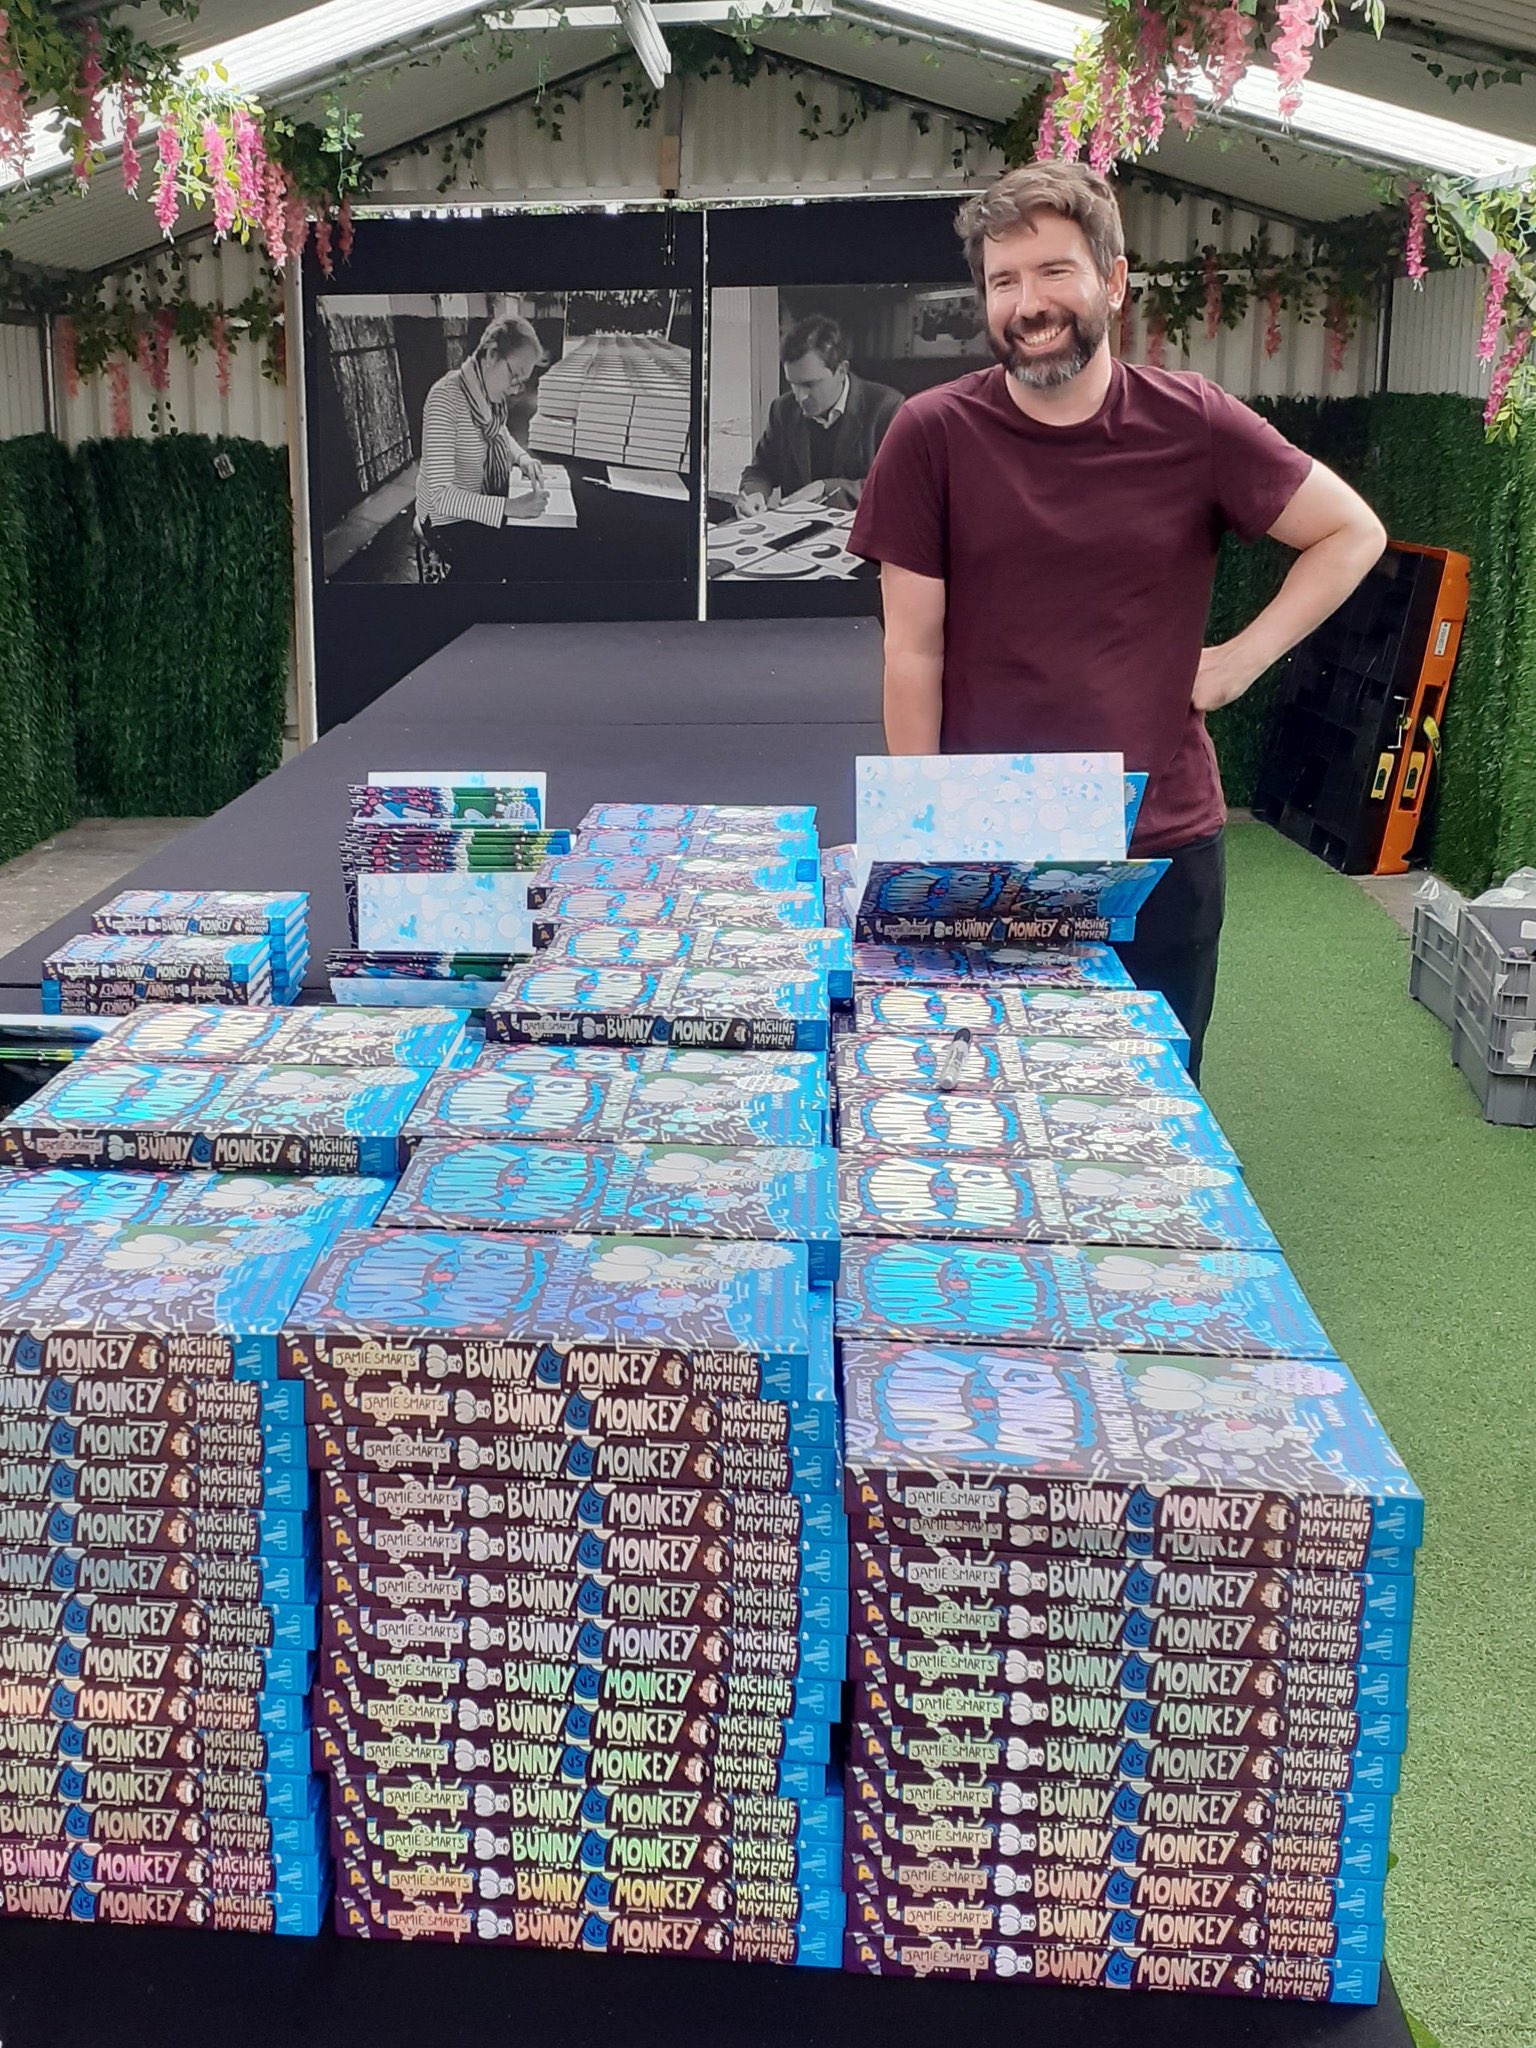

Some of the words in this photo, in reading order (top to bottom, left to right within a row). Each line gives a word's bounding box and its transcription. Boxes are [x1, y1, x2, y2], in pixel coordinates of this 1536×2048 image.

[954, 920, 994, 940] BUNNY
[1008, 920, 1056, 938] MONKEY
[1074, 920, 1110, 931] MACHINE
[156, 963, 192, 979] MONKEY
[522, 1022, 548, 1033] JAMIE
[606, 1020, 653, 1041] BUNNY
[672, 1021, 730, 1042] MONKEY
[753, 1021, 795, 1034] MACHINE
[753, 1033, 794, 1046] MAYHEM!
[39, 1139, 68, 1150] JAMIE
[138, 1135, 195, 1163] BUNNY
[214, 1138, 283, 1164] MONKEY
[308, 1139, 358, 1154] MACHINE
[308, 1154, 357, 1169] MAYHEM!
[431, 1144, 526, 1214] BUNNY
[504, 1147, 588, 1220] MONKEY
[348, 1234, 456, 1321] BUNNY
[428, 1238, 528, 1325] MONKEY
[872, 1243, 963, 1325] BUNNY
[954, 1248, 1039, 1330] MONKEY
[21, 1346, 37, 1361] VS
[45, 1337, 136, 1370] MONKEY
[167, 1337, 232, 1358] MACHINE
[167, 1357, 231, 1376] MAYHEM!
[335, 1351, 371, 1366] JAMIE
[466, 1347, 537, 1384] BUNNY
[541, 1360, 558, 1373] VS
[566, 1351, 657, 1384] MONKEY
[693, 1353, 758, 1375] MACHINE
[693, 1374, 758, 1392] MAYHEM!
[884, 1349, 990, 1453] BUNNY
[978, 1354, 1079, 1461] MONKEY
[1102, 1412, 1146, 1460] MACHINE
[377, 1491, 414, 1506] JAMIE
[506, 1487, 578, 1521] BUNNY
[585, 1501, 600, 1515] VS
[608, 1492, 700, 1526] MONKEY
[734, 1495, 800, 1517] MACHINE
[908, 1490, 947, 1505] JAMIE
[1051, 1488, 1129, 1524] BUNNY
[1132, 1502, 1150, 1516] VS
[1160, 1495, 1261, 1530] MONKEY
[1300, 1501, 1371, 1521] MACHINE
[733, 1516, 799, 1536] MAYHEM!
[1299, 1520, 1370, 1540] MAYHEM!
[56, 1564, 73, 1578] VS
[80, 1557, 166, 1590] MONKEY
[198, 1560, 259, 1581] MACHINE
[198, 1578, 259, 1597] MAYHEM!
[910, 1610, 946, 1624] JAMIE
[1049, 1610, 1126, 1644] BUNNY
[1130, 1624, 1148, 1637] VS
[1155, 1617, 1253, 1651] MONKEY
[1289, 1623, 1358, 1642] MACHINE
[1288, 1641, 1357, 1660] MAYHEM!
[377, 1663, 410, 1677] JAMIE
[505, 1661, 575, 1694] BUNNY
[578, 1675, 596, 1688] VS
[604, 1669, 694, 1702] MONKEY
[728, 1677, 792, 1698] MACHINE
[56, 1695, 70, 1709] VS
[78, 1690, 163, 1721] MONKEY
[195, 1694, 255, 1712] MACHINE
[728, 1696, 792, 1715] MAYHEM!
[195, 1711, 254, 1730] MAYHEM!
[912, 1743, 948, 1757] JAMIE
[1047, 1742, 1122, 1776] BUNNY
[1126, 1754, 1143, 1767] VS
[1152, 1747, 1246, 1780] MONKEY
[1282, 1751, 1350, 1770] MACHINE
[1282, 1769, 1348, 1788] MAYHEM!
[1, 1807, 65, 1836] BUNNY
[71, 1816, 86, 1831] VS
[94, 1809, 179, 1842] MONKEY
[209, 1815, 270, 1834] MACHINE
[210, 1831, 269, 1849] MAYHEM!
[386, 1832, 420, 1846] JAMIE
[512, 1832, 582, 1866] BUNNY
[586, 1844, 604, 1857] VS
[610, 1838, 700, 1874] MONKEY
[732, 1841, 795, 1863] MACHINE
[2, 1849, 69, 1882] BUNNY
[76, 1857, 90, 1872] VS
[96, 1853, 179, 1884] MONKEY
[213, 1856, 271, 1876] MACHINE
[732, 1860, 795, 1880] MAYHEM!
[213, 1873, 270, 1891] MAYHEM!
[901, 1870, 937, 1883] JAMIE
[1034, 1868, 1110, 1901] BUNNY
[1112, 1881, 1129, 1894] VS
[1136, 1875, 1231, 1908] MONKEY
[1266, 1880, 1333, 1900] MACHINE
[5, 1885, 71, 1915] BUNNY
[76, 1898, 90, 1913] VS
[100, 1890, 183, 1922] MONKEY
[214, 1894, 273, 1915] MACHINE
[1265, 1899, 1330, 1917] MAYHEM!
[214, 1912, 273, 1931] MAYHEM!
[390, 1912, 422, 1927] JAMIE
[515, 1909, 584, 1944] BUNNY
[588, 1925, 605, 1938] VS
[612, 1920, 700, 1954] MONKEY
[733, 1925, 796, 1944] MACHINE
[733, 1941, 795, 1961] MAYHEM!
[902, 1950, 938, 1962] JAMIE
[1035, 1949, 1110, 1982] BUNNY
[1112, 1962, 1129, 1974] VS
[1137, 1957, 1229, 1988] MONKEY
[1265, 1961, 1329, 1980] MACHINE
[1264, 1978, 1329, 1996] MAYHEM!
